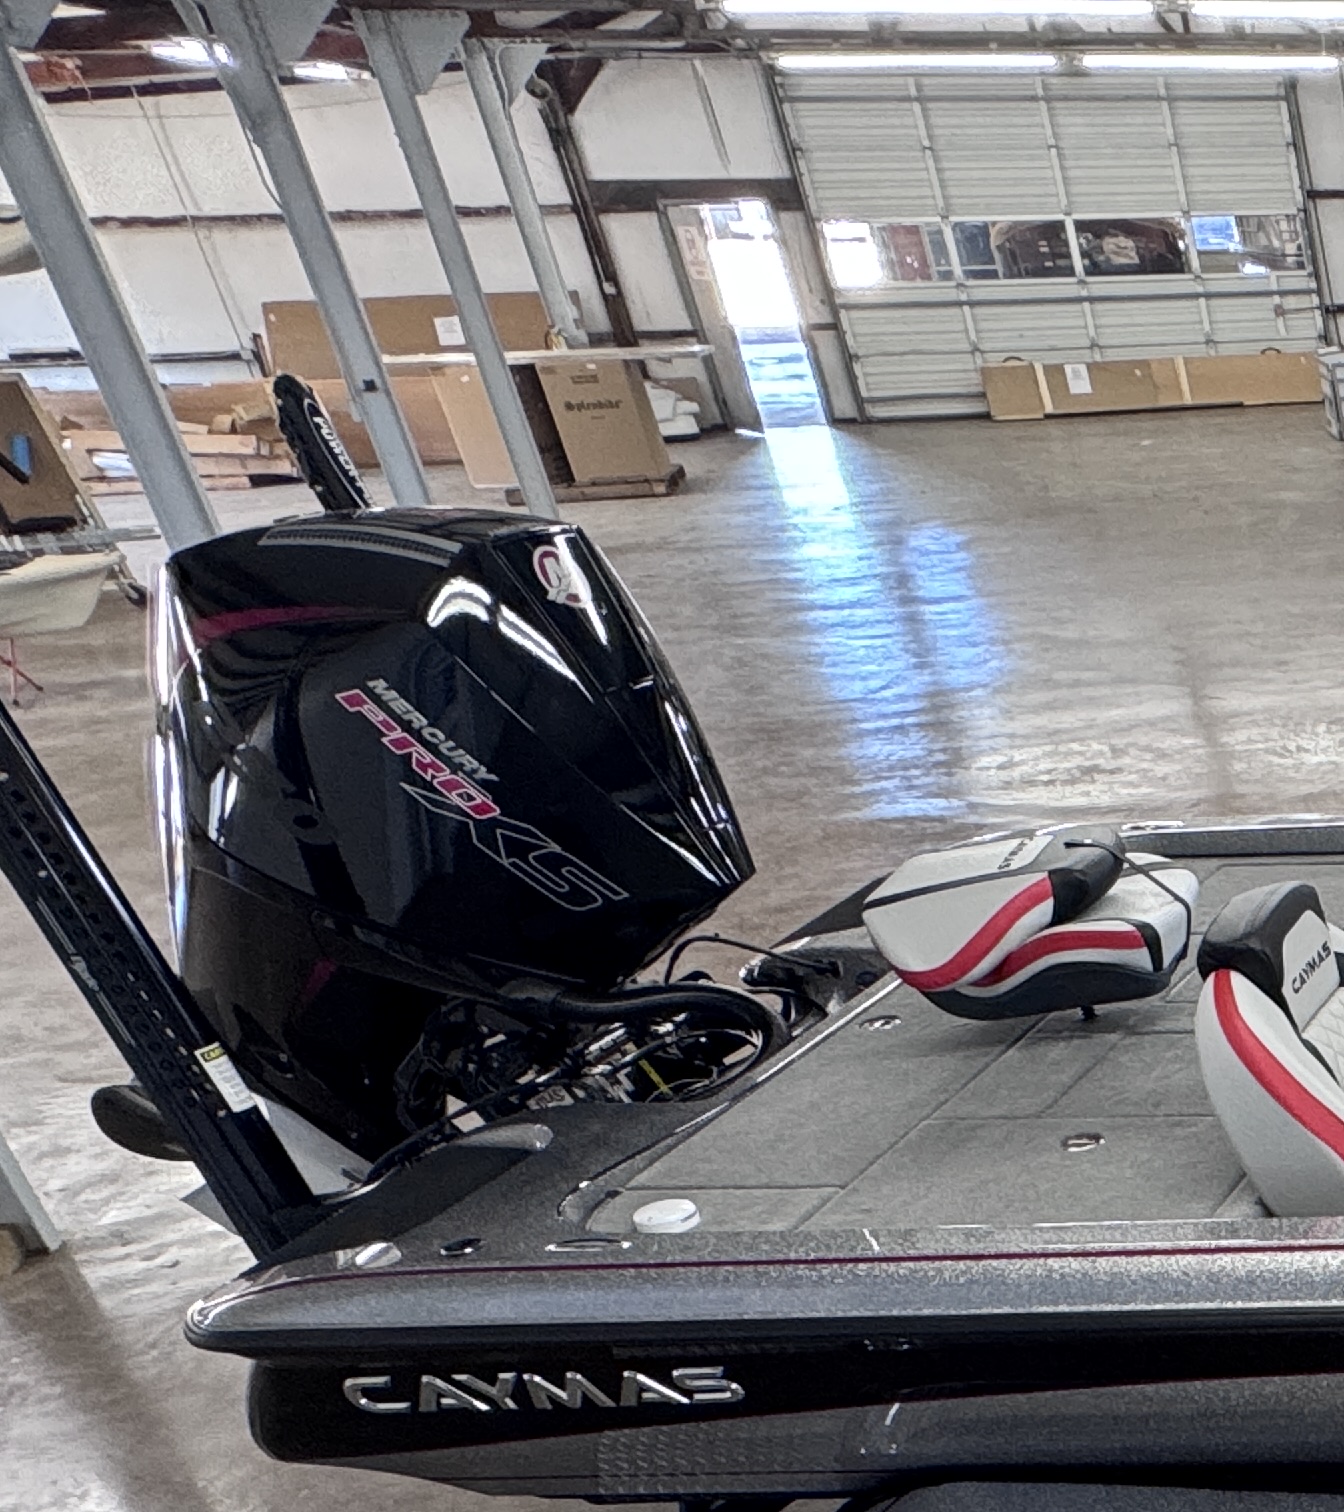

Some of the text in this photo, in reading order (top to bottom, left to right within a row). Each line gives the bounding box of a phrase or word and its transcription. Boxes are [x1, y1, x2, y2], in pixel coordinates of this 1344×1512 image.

[334, 688, 501, 820] PRO
[366, 677, 500, 782] MERCURY
[399, 778, 631, 912] XS
[1291, 940, 1332, 995] CAYMAS
[342, 1365, 746, 1413] CAYMAS
